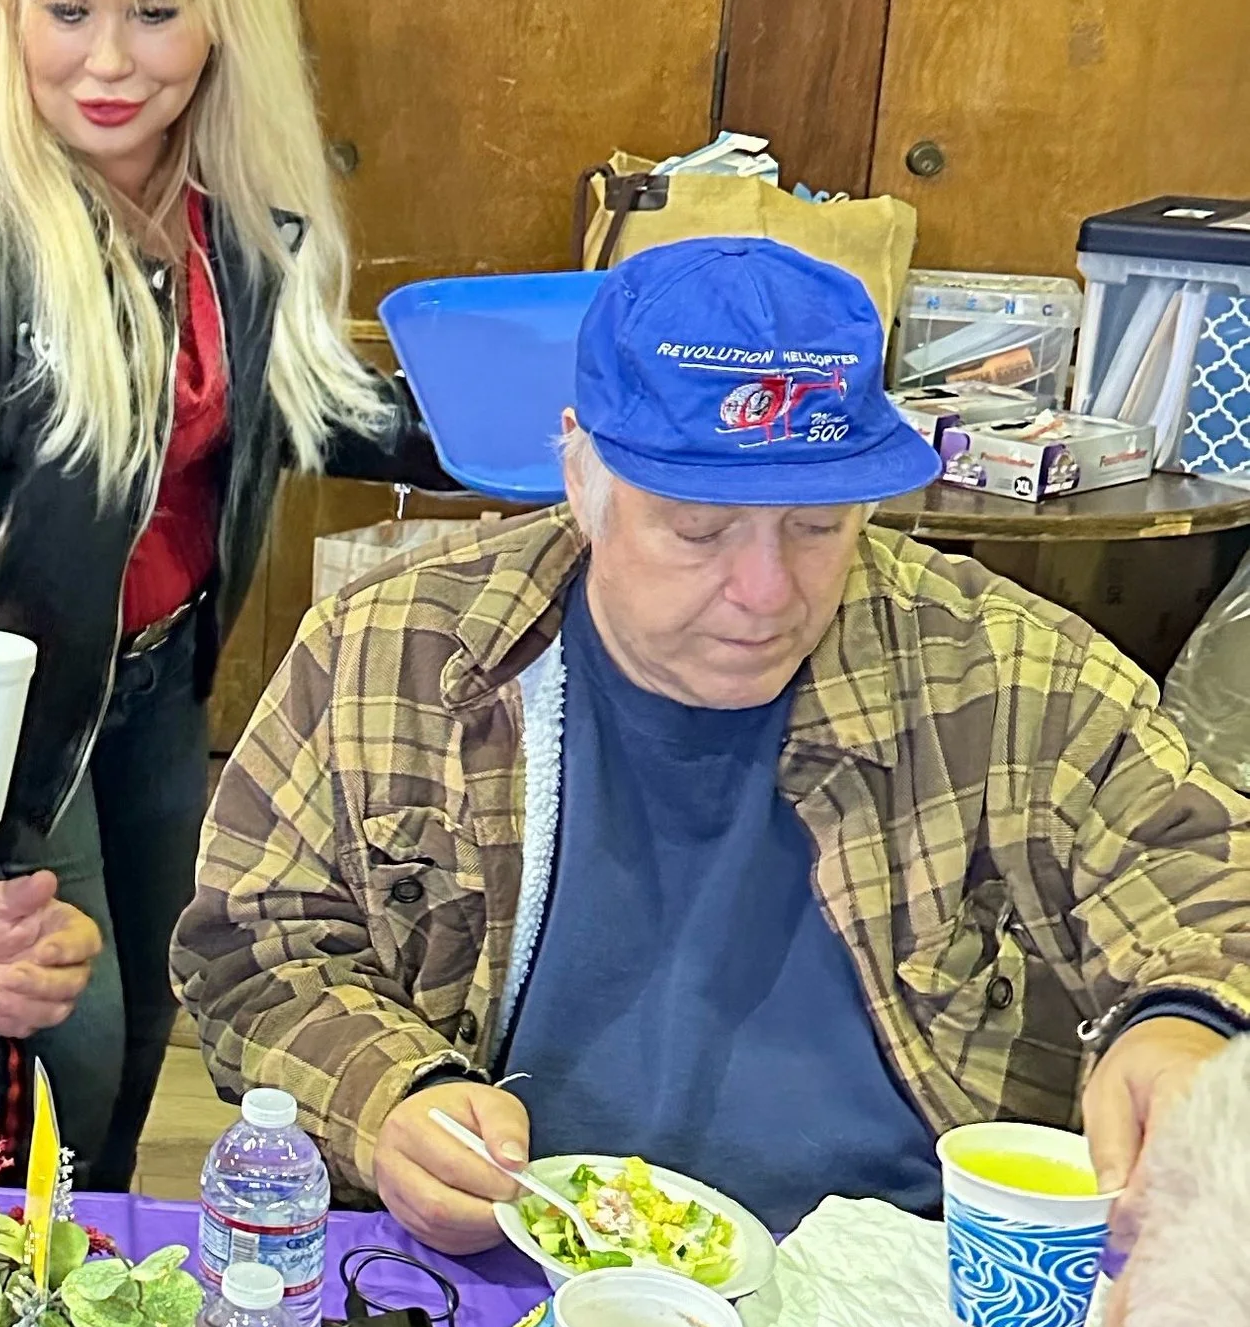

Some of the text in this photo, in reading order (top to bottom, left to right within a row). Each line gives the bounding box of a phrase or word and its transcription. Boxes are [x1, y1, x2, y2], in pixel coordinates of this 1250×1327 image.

[656, 342, 859, 367] REVOLUTION HELICOPTER
[806, 423, 850, 442] 500
[1014, 478, 1031, 494] XL
